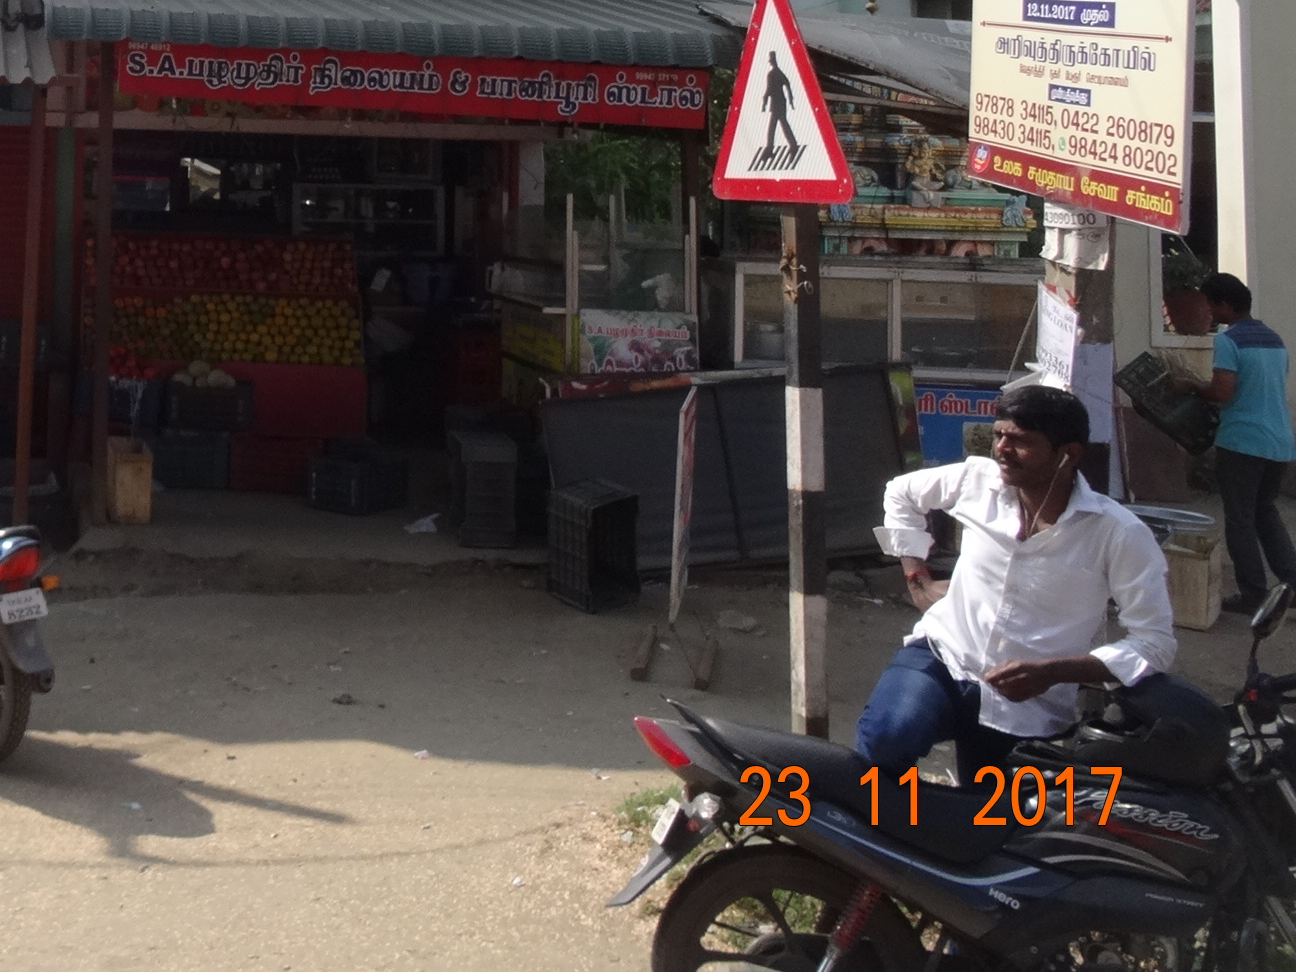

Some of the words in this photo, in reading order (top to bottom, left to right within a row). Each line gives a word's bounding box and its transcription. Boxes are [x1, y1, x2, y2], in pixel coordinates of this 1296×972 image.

[1026, 2, 1076, 21] 12.11.2017
[1080, 3, 1109, 25] முதல்
[995, 34, 1157, 73] அறிவுத்திருக்கோயில்
[310, 58, 440, 96] நிலையம்
[449, 72, 468, 95] &
[477, 69, 598, 116] பானிபூரி
[605, 72, 703, 109] ஸ்டால்
[973, 117, 1015, 142] 98430
[1018, 125, 1055, 152] 34115,
[1068, 136, 1118, 165] 98424
[1123, 145, 1178, 177] 80202
[975, 93, 1015, 118] 97878
[1020, 101, 1057, 127] 34115,
[1061, 107, 1099, 135] 0422
[1106, 116, 1175, 147] 2608179
[993, 155, 1022, 177] உலக
[1027, 164, 1074, 193] சமுதாய
[1081, 175, 1118, 202] சேவா
[1125, 185, 1172, 216] சங்கம்
[988, 886, 1020, 910] Hero
